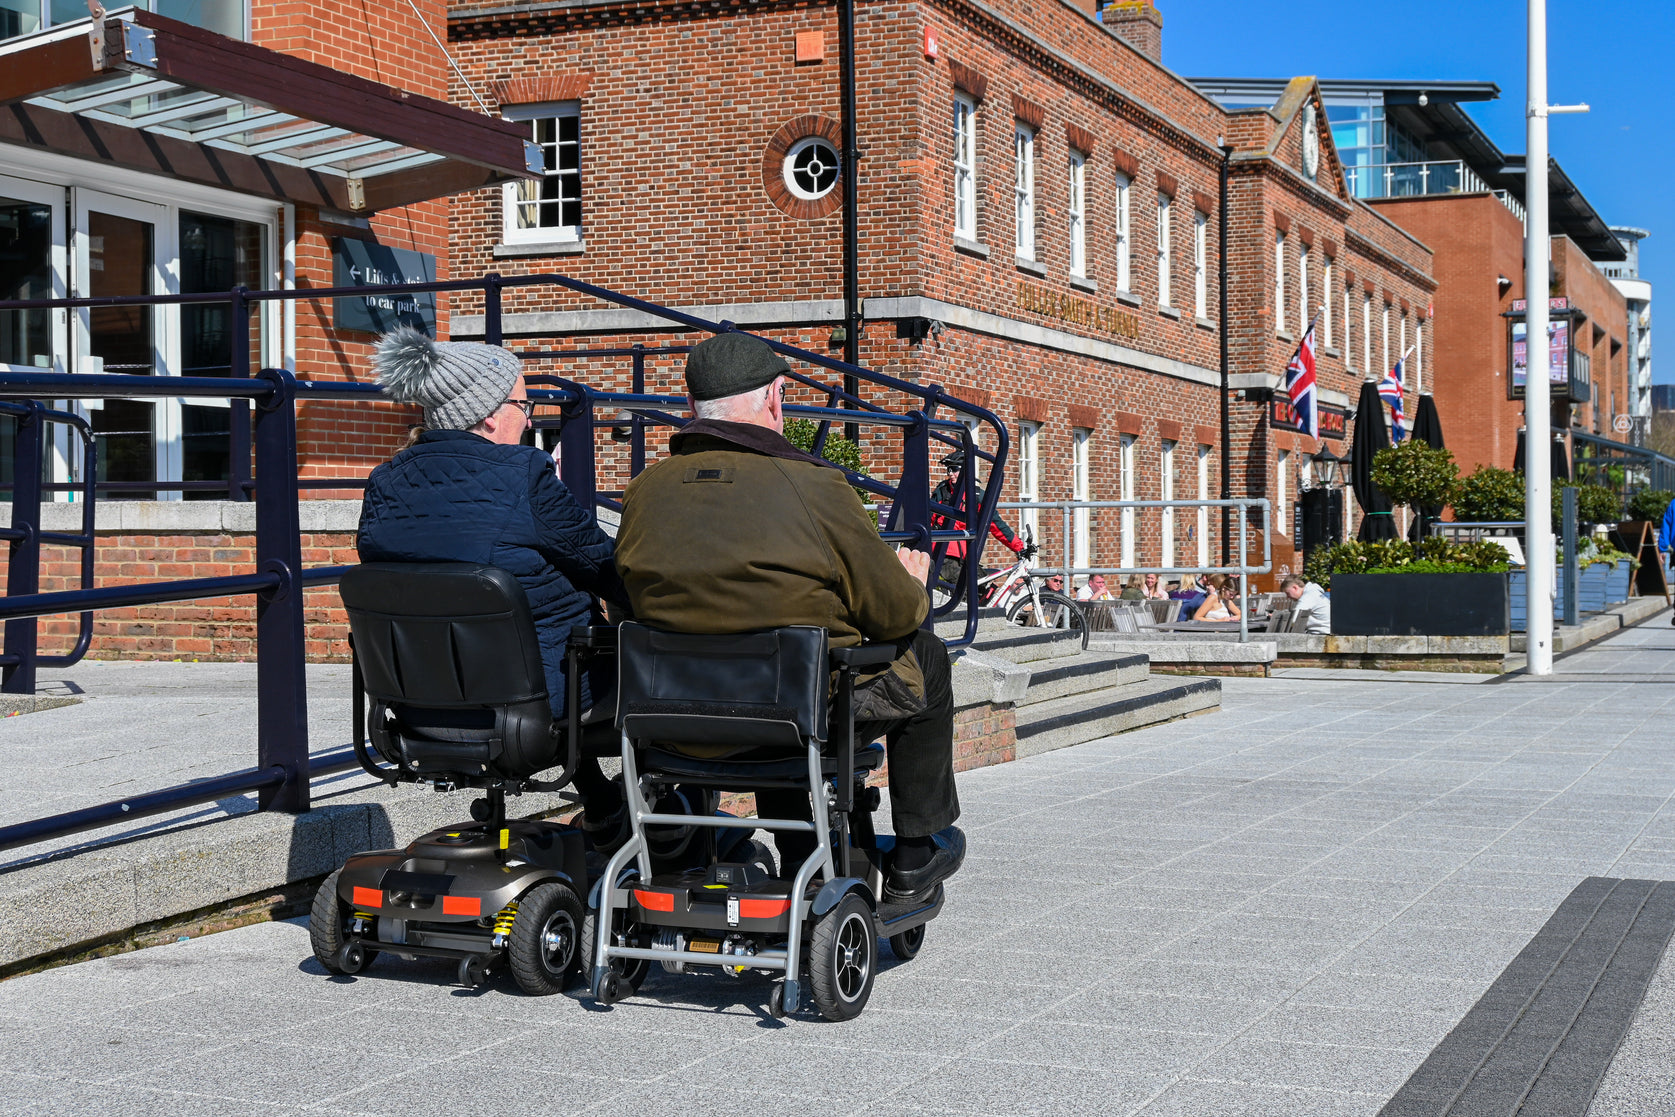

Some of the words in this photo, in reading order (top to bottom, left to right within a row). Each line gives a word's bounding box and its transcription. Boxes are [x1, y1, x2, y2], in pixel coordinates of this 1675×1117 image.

[365, 267, 388, 285] Lifts
[391, 272, 400, 285] &
[366, 295, 376, 307] to
[378, 297, 395, 310] car
[397, 298, 420, 316] park
[1016, 281, 1056, 318] FULLER
[1059, 293, 1092, 328] SMITH
[1104, 306, 1140, 340] TURNER
